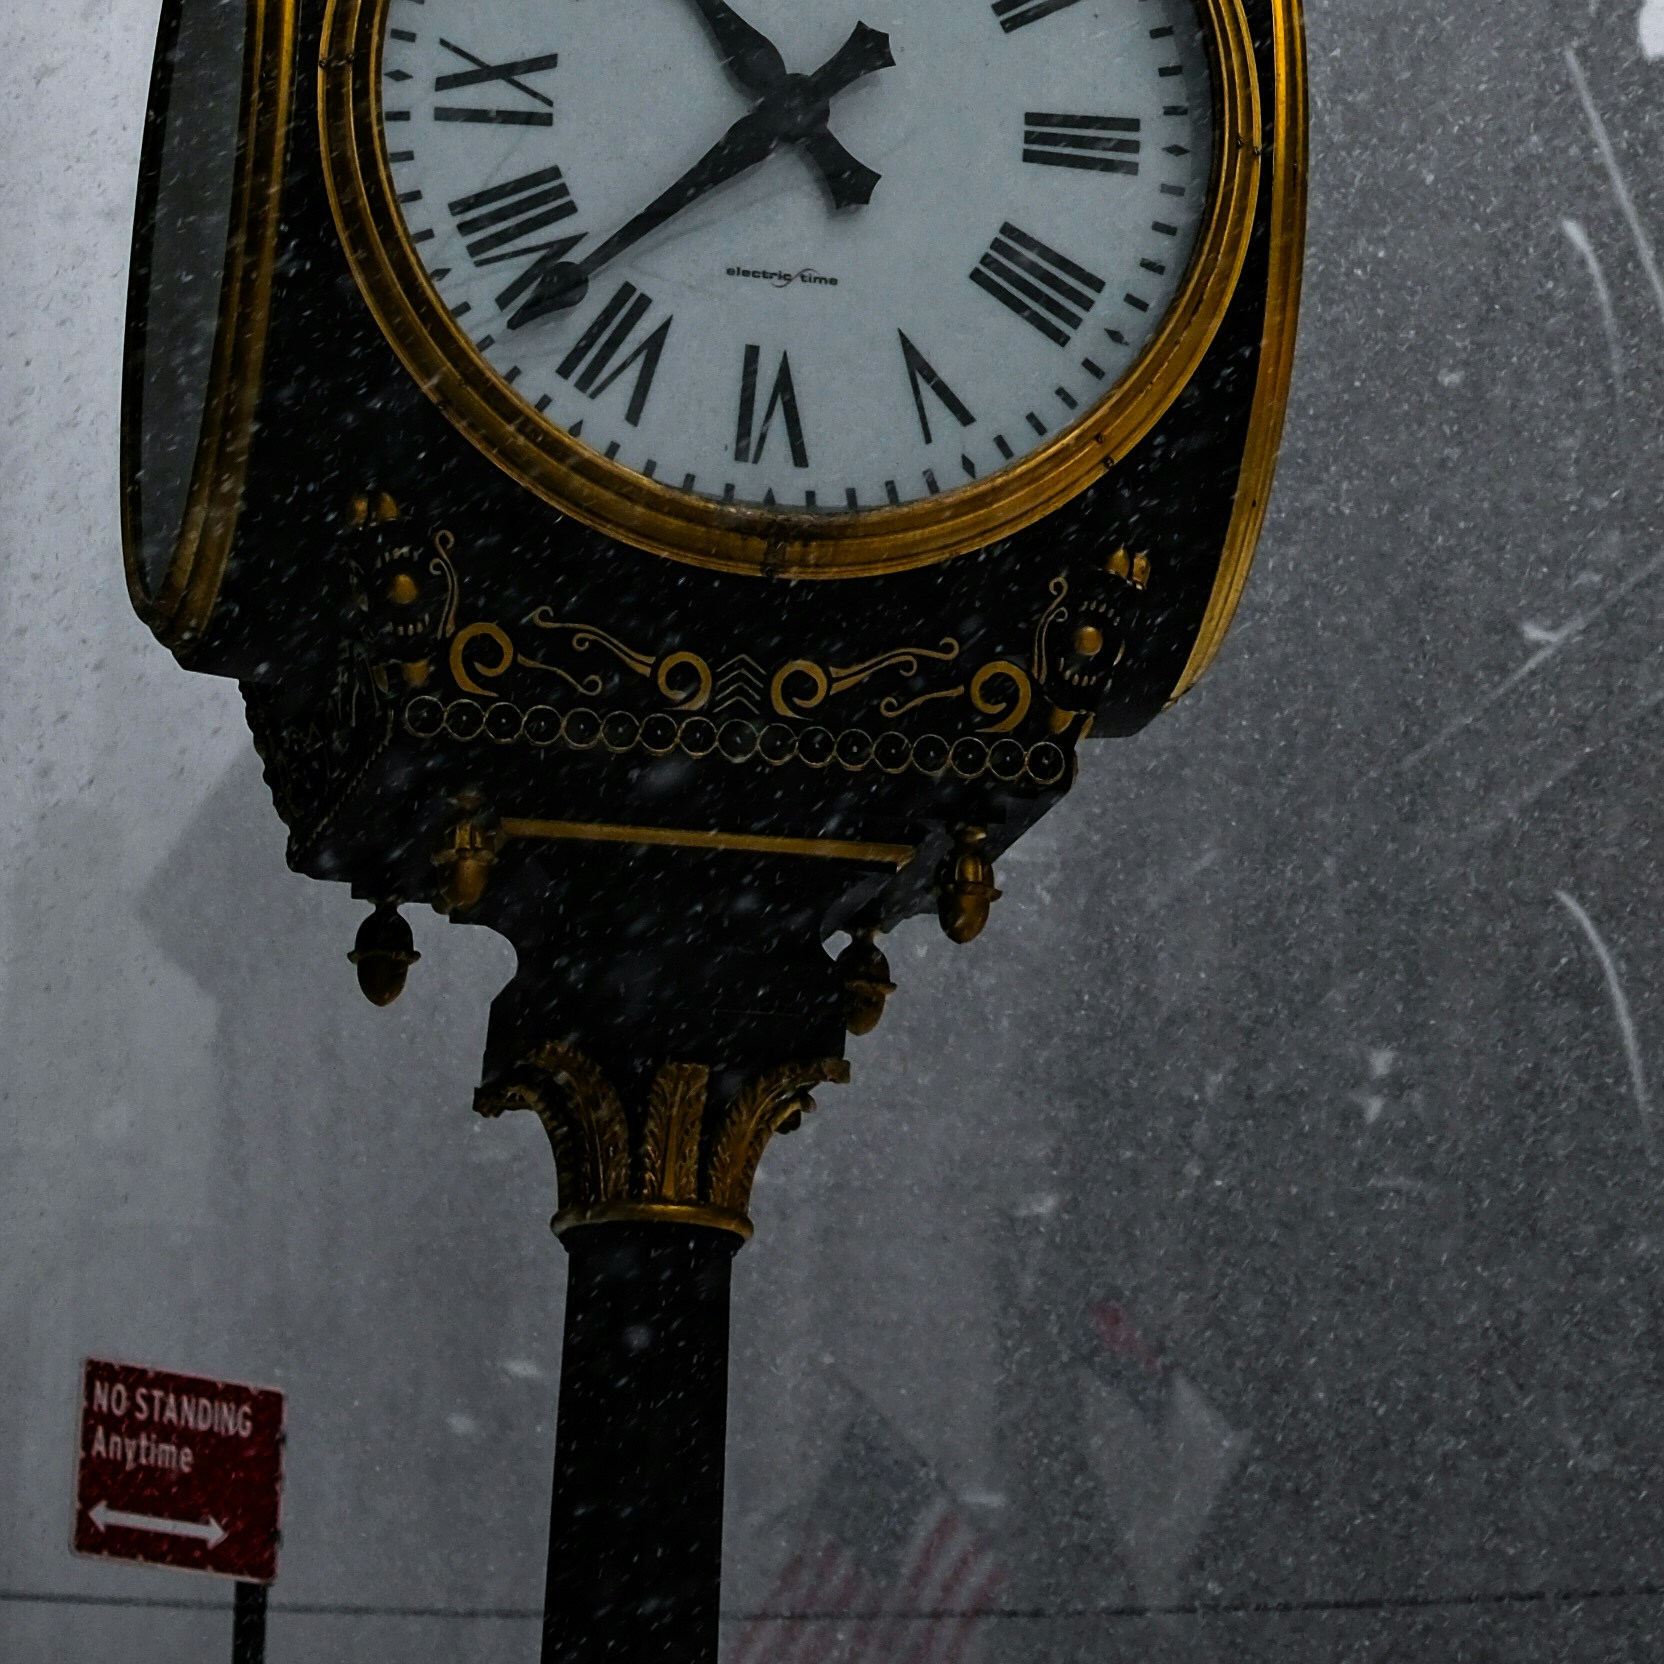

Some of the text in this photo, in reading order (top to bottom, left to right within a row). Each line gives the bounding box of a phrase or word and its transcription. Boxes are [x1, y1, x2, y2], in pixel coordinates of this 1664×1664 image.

[434, 37, 559, 127] IX
[1022, 111, 1142, 176] III
[447, 164, 590, 312] VIII
[726, 266, 838, 285] electric time
[968, 221, 1107, 348] IIII
[555, 280, 674, 428] VII
[897, 327, 977, 445] V
[734, 344, 809, 469] VI
[91, 1425, 194, 1473] Anytime
[93, 1379, 254, 1438] NO STANDING
